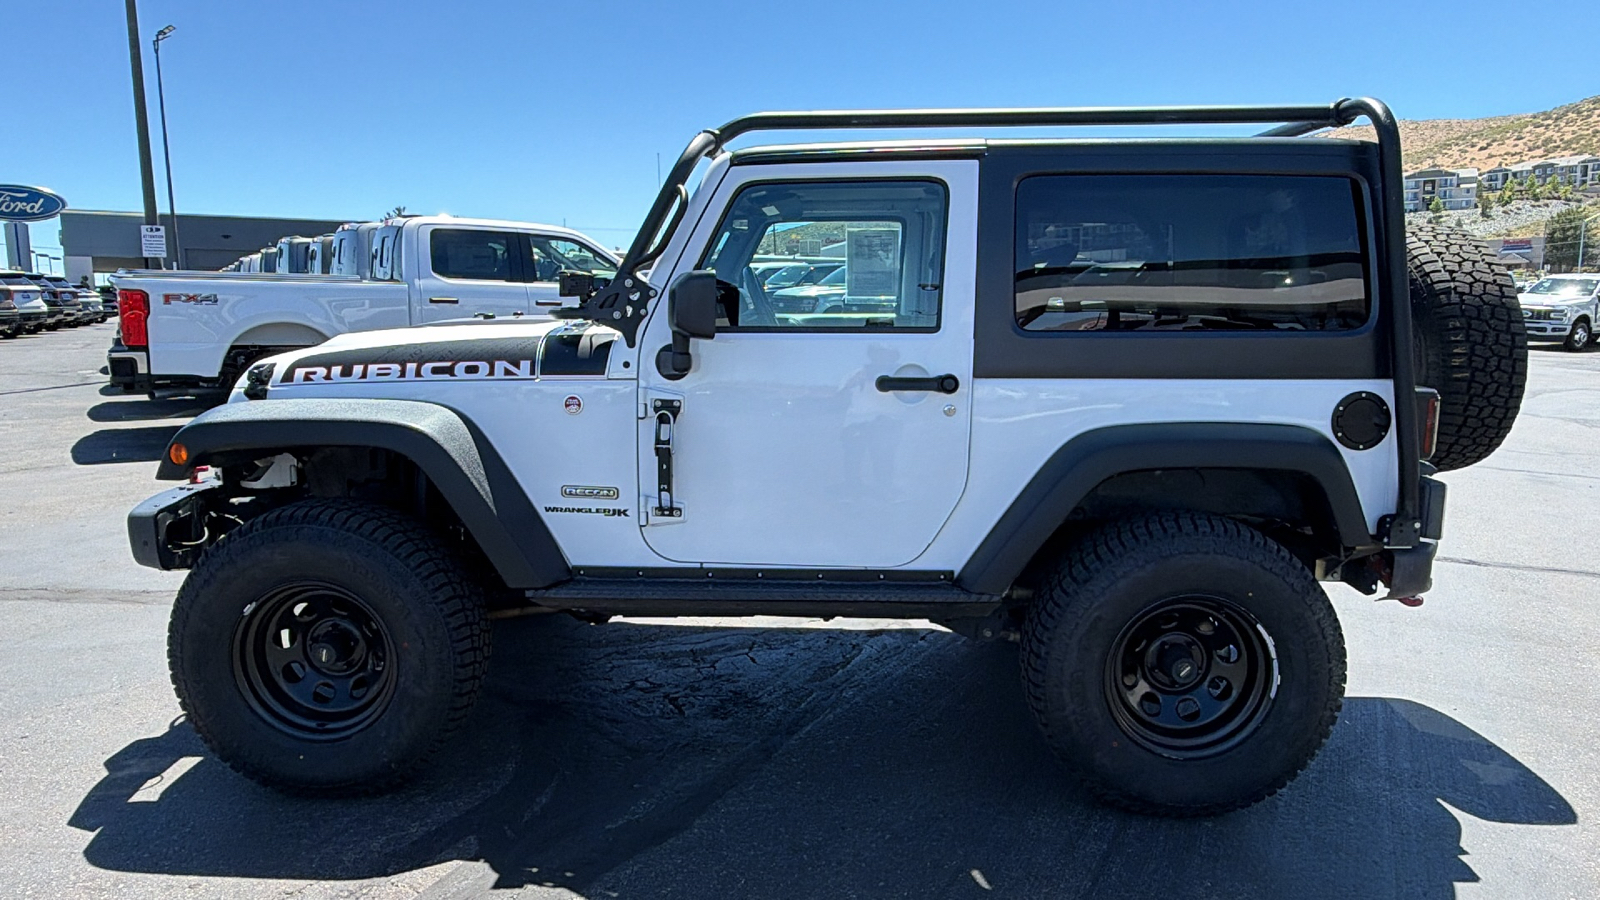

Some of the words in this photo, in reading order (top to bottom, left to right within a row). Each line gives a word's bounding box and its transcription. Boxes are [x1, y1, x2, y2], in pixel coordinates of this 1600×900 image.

[163, 293, 218, 305] FX4
[293, 360, 532, 383] RUBICON
[566, 488, 614, 496] RECON
